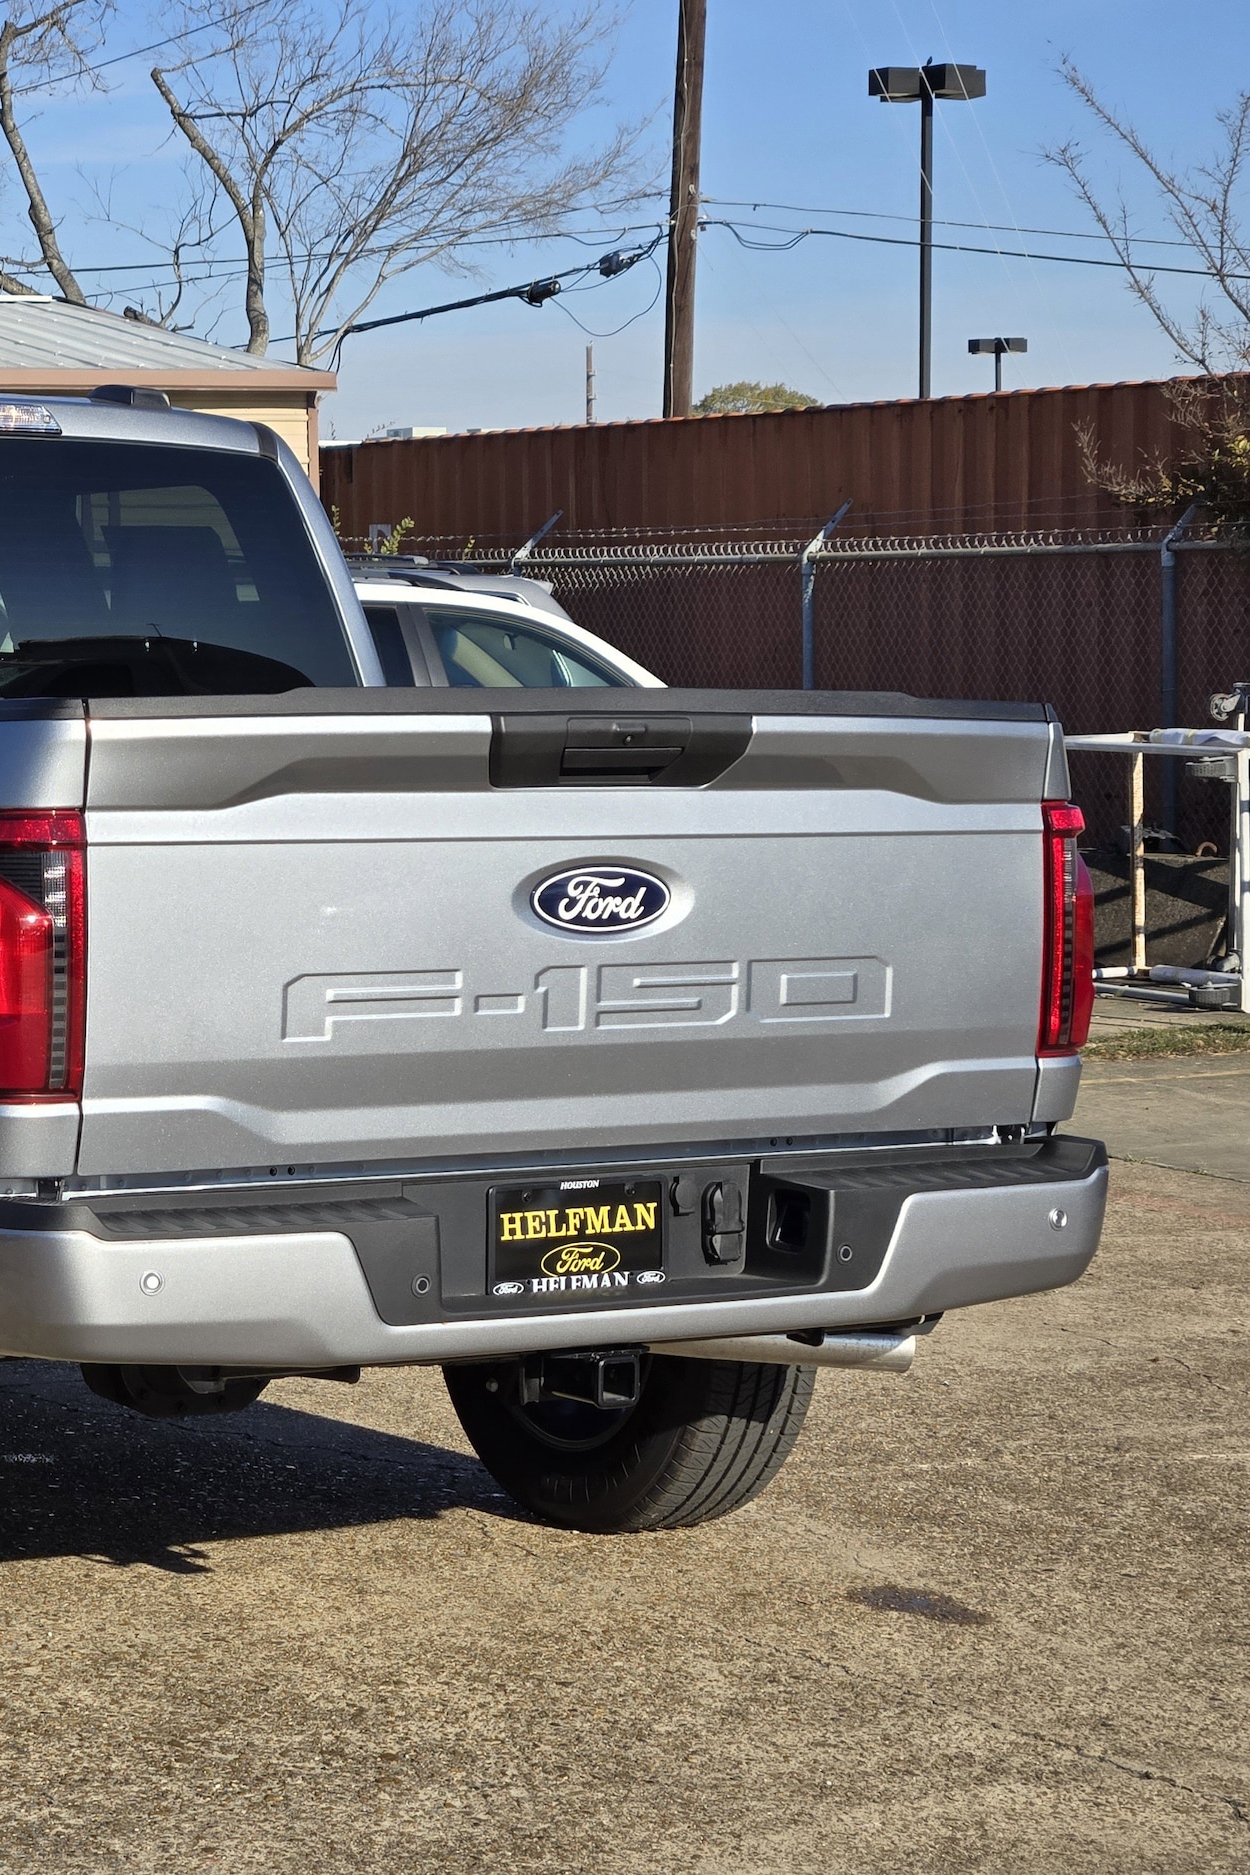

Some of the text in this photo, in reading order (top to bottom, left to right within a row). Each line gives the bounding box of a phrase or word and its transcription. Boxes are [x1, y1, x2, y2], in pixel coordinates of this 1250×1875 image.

[557, 875, 646, 921] Ford
[281, 955, 893, 1043] F-150
[560, 1179, 600, 1190] HOUSTON
[500, 1202, 658, 1241] HELFMAN
[556, 1246, 606, 1274] Ford
